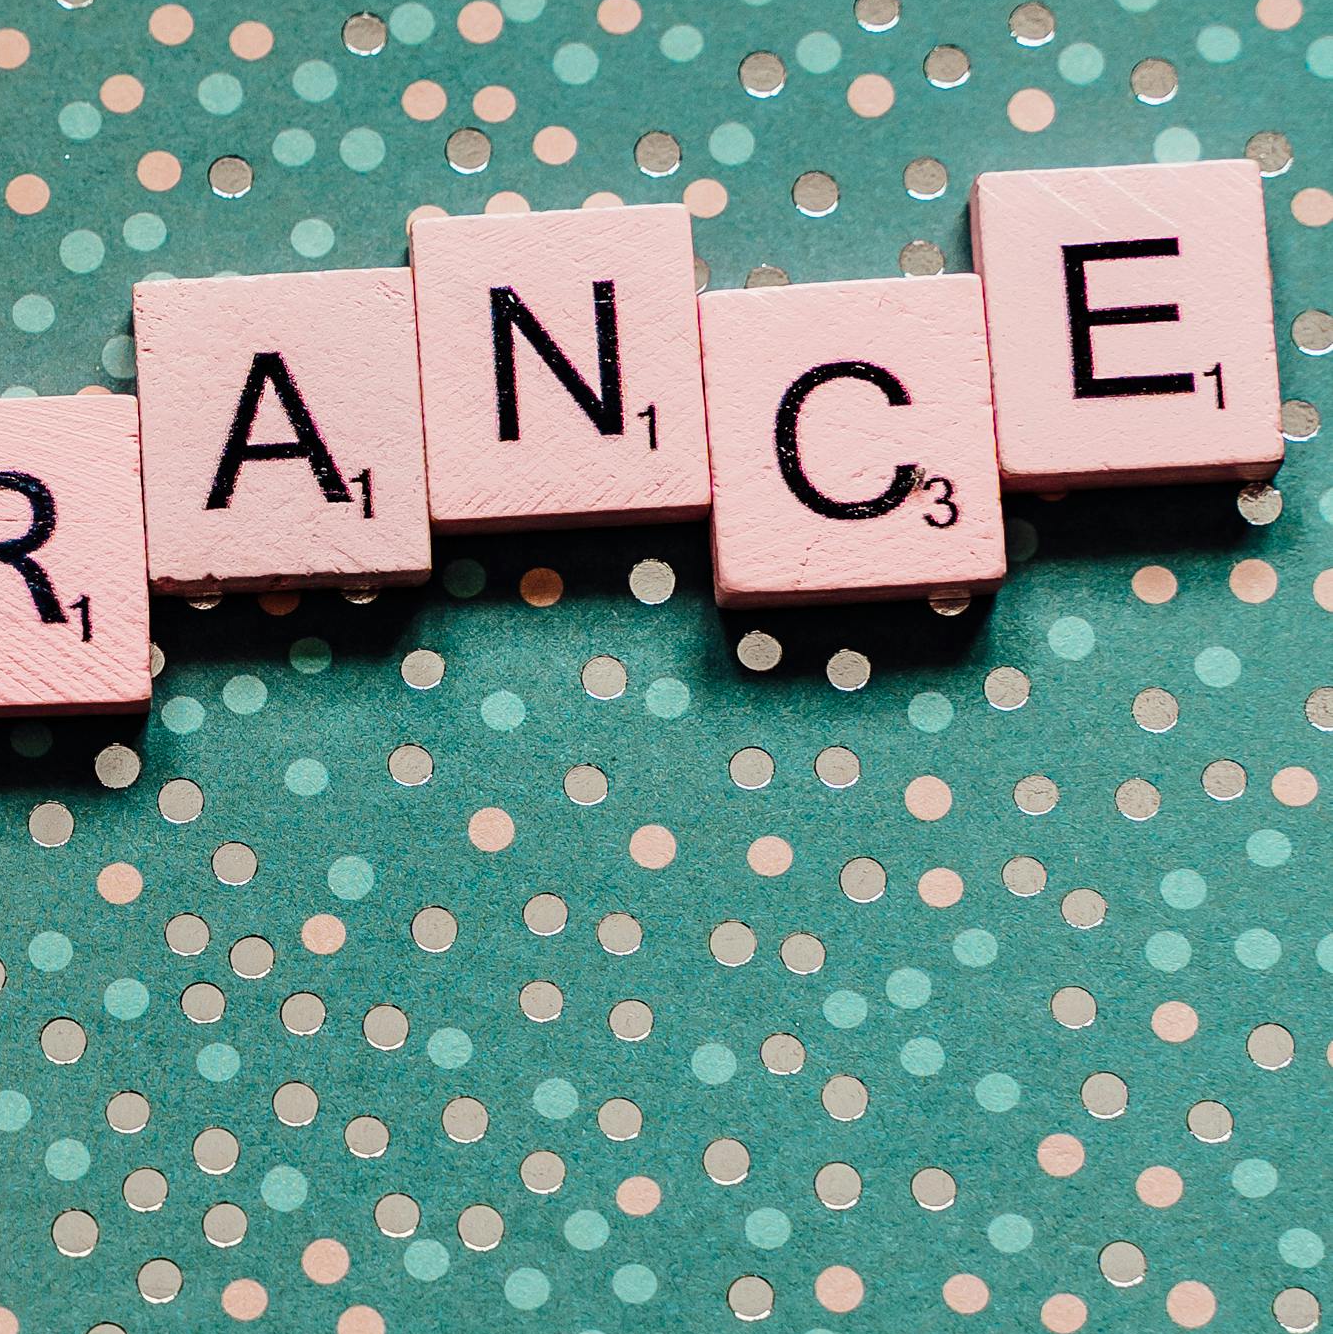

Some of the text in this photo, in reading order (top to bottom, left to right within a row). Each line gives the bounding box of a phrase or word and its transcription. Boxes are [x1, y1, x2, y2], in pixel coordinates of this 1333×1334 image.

[1202, 361, 1227, 411] 1
[636, 403, 659, 452] 1
[348, 466, 375, 520] 1
[922, 475, 960, 530] 3
[68, 594, 94, 645] 1
